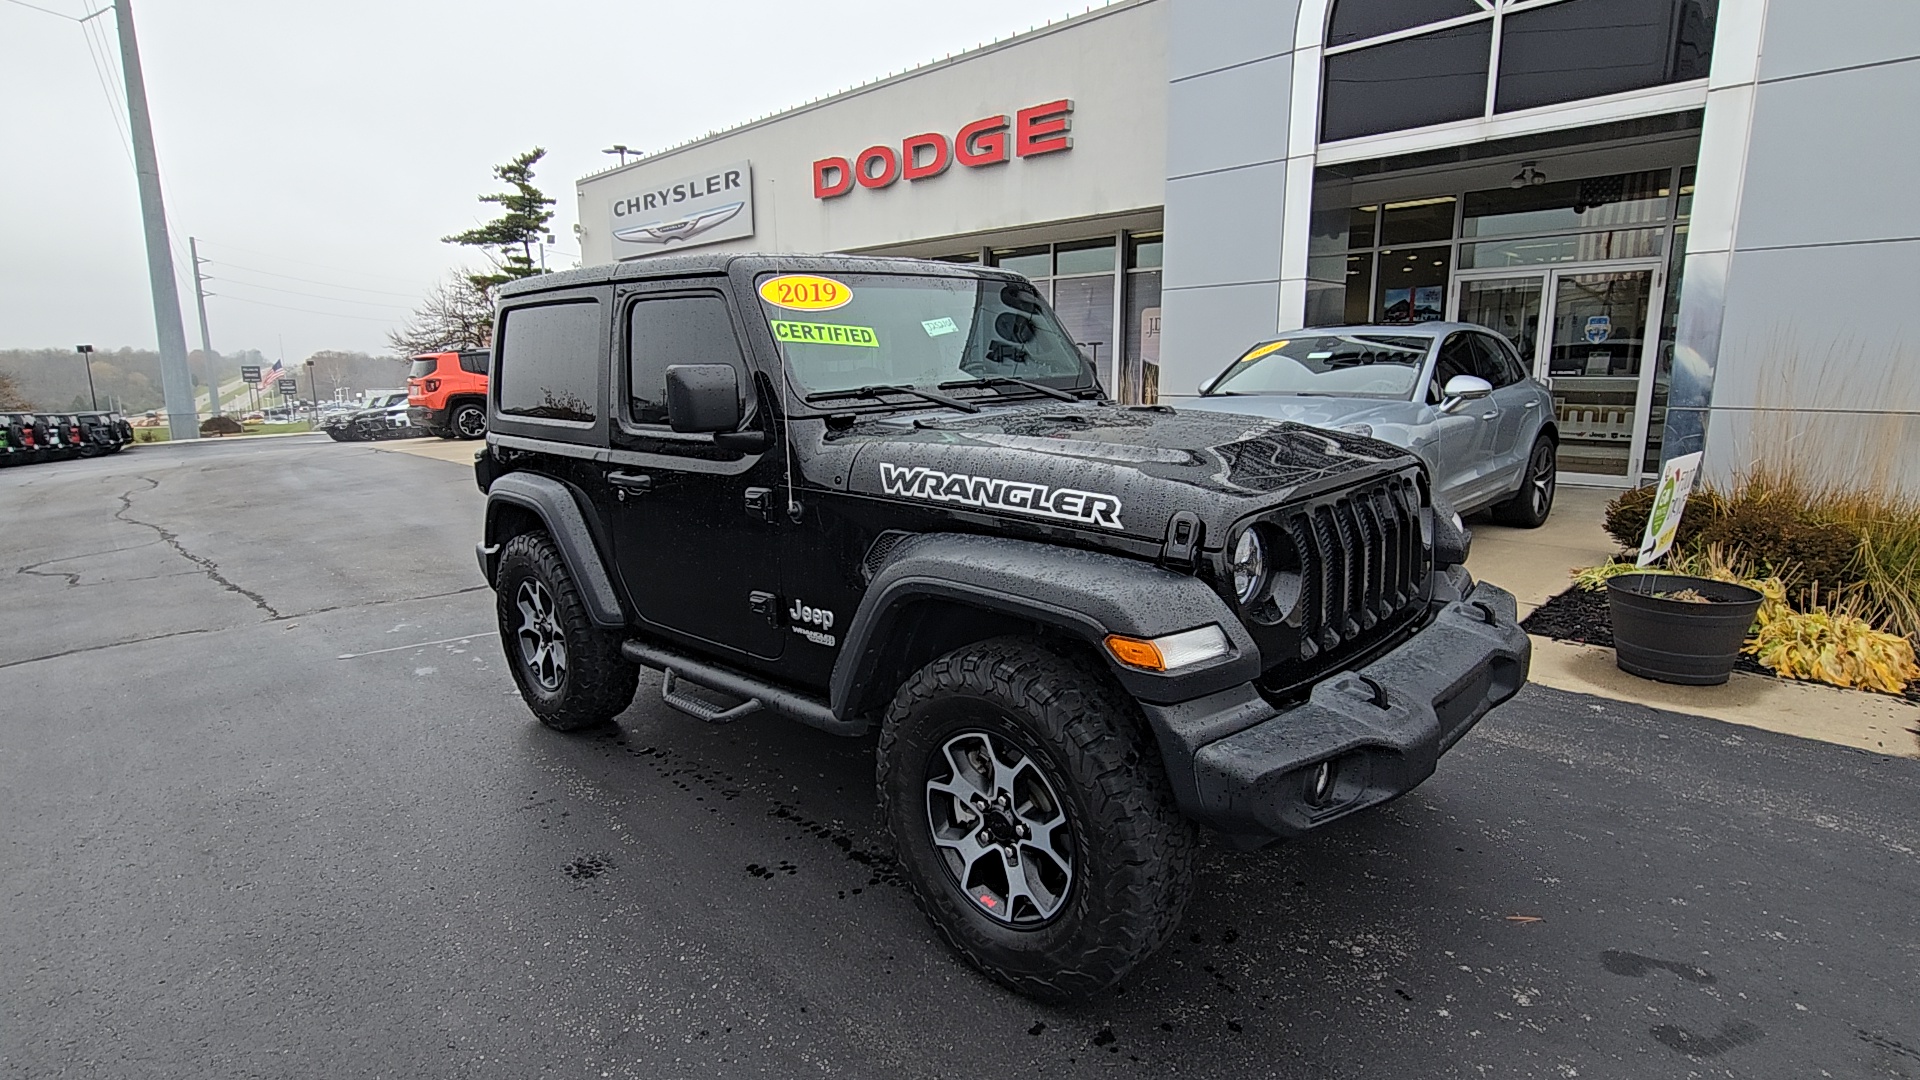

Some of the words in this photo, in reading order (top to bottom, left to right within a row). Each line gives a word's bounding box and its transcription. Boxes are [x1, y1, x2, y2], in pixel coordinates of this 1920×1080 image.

[812, 98, 1073, 200] DODGE
[613, 170, 741, 218] CHRYSLER
[778, 283, 837, 303] 2019
[775, 322, 873, 343] CERTIFIED
[879, 462, 1125, 531] WRANGLER
[789, 598, 834, 631] Jeep
